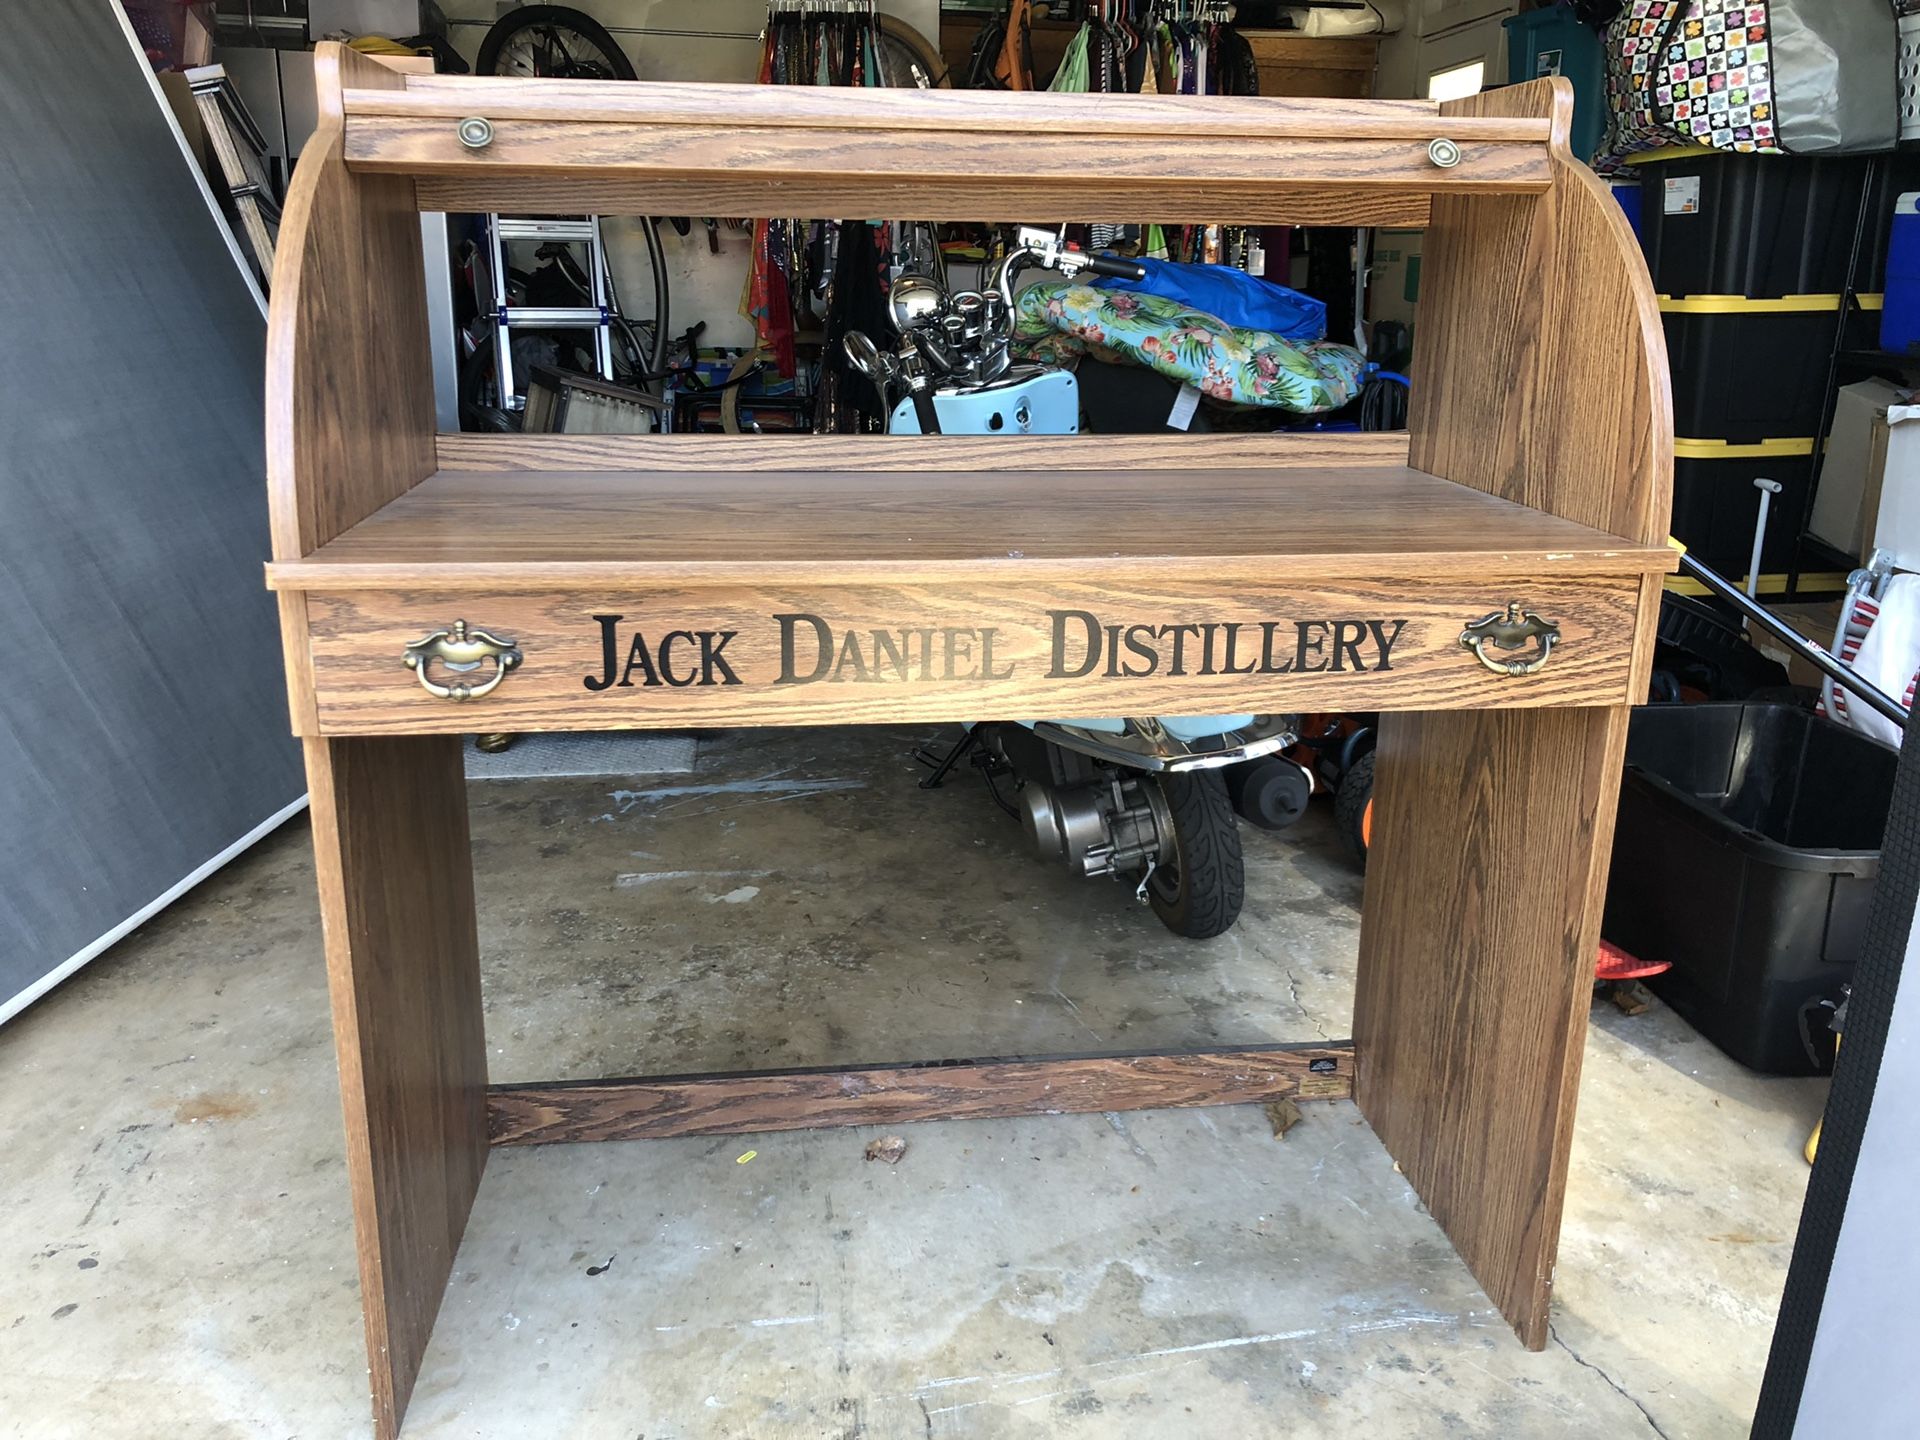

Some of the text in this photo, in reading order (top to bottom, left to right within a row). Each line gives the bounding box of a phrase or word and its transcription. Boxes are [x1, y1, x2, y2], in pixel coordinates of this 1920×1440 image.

[584, 610, 1408, 691] JACK DANIEL DISTILLERY
